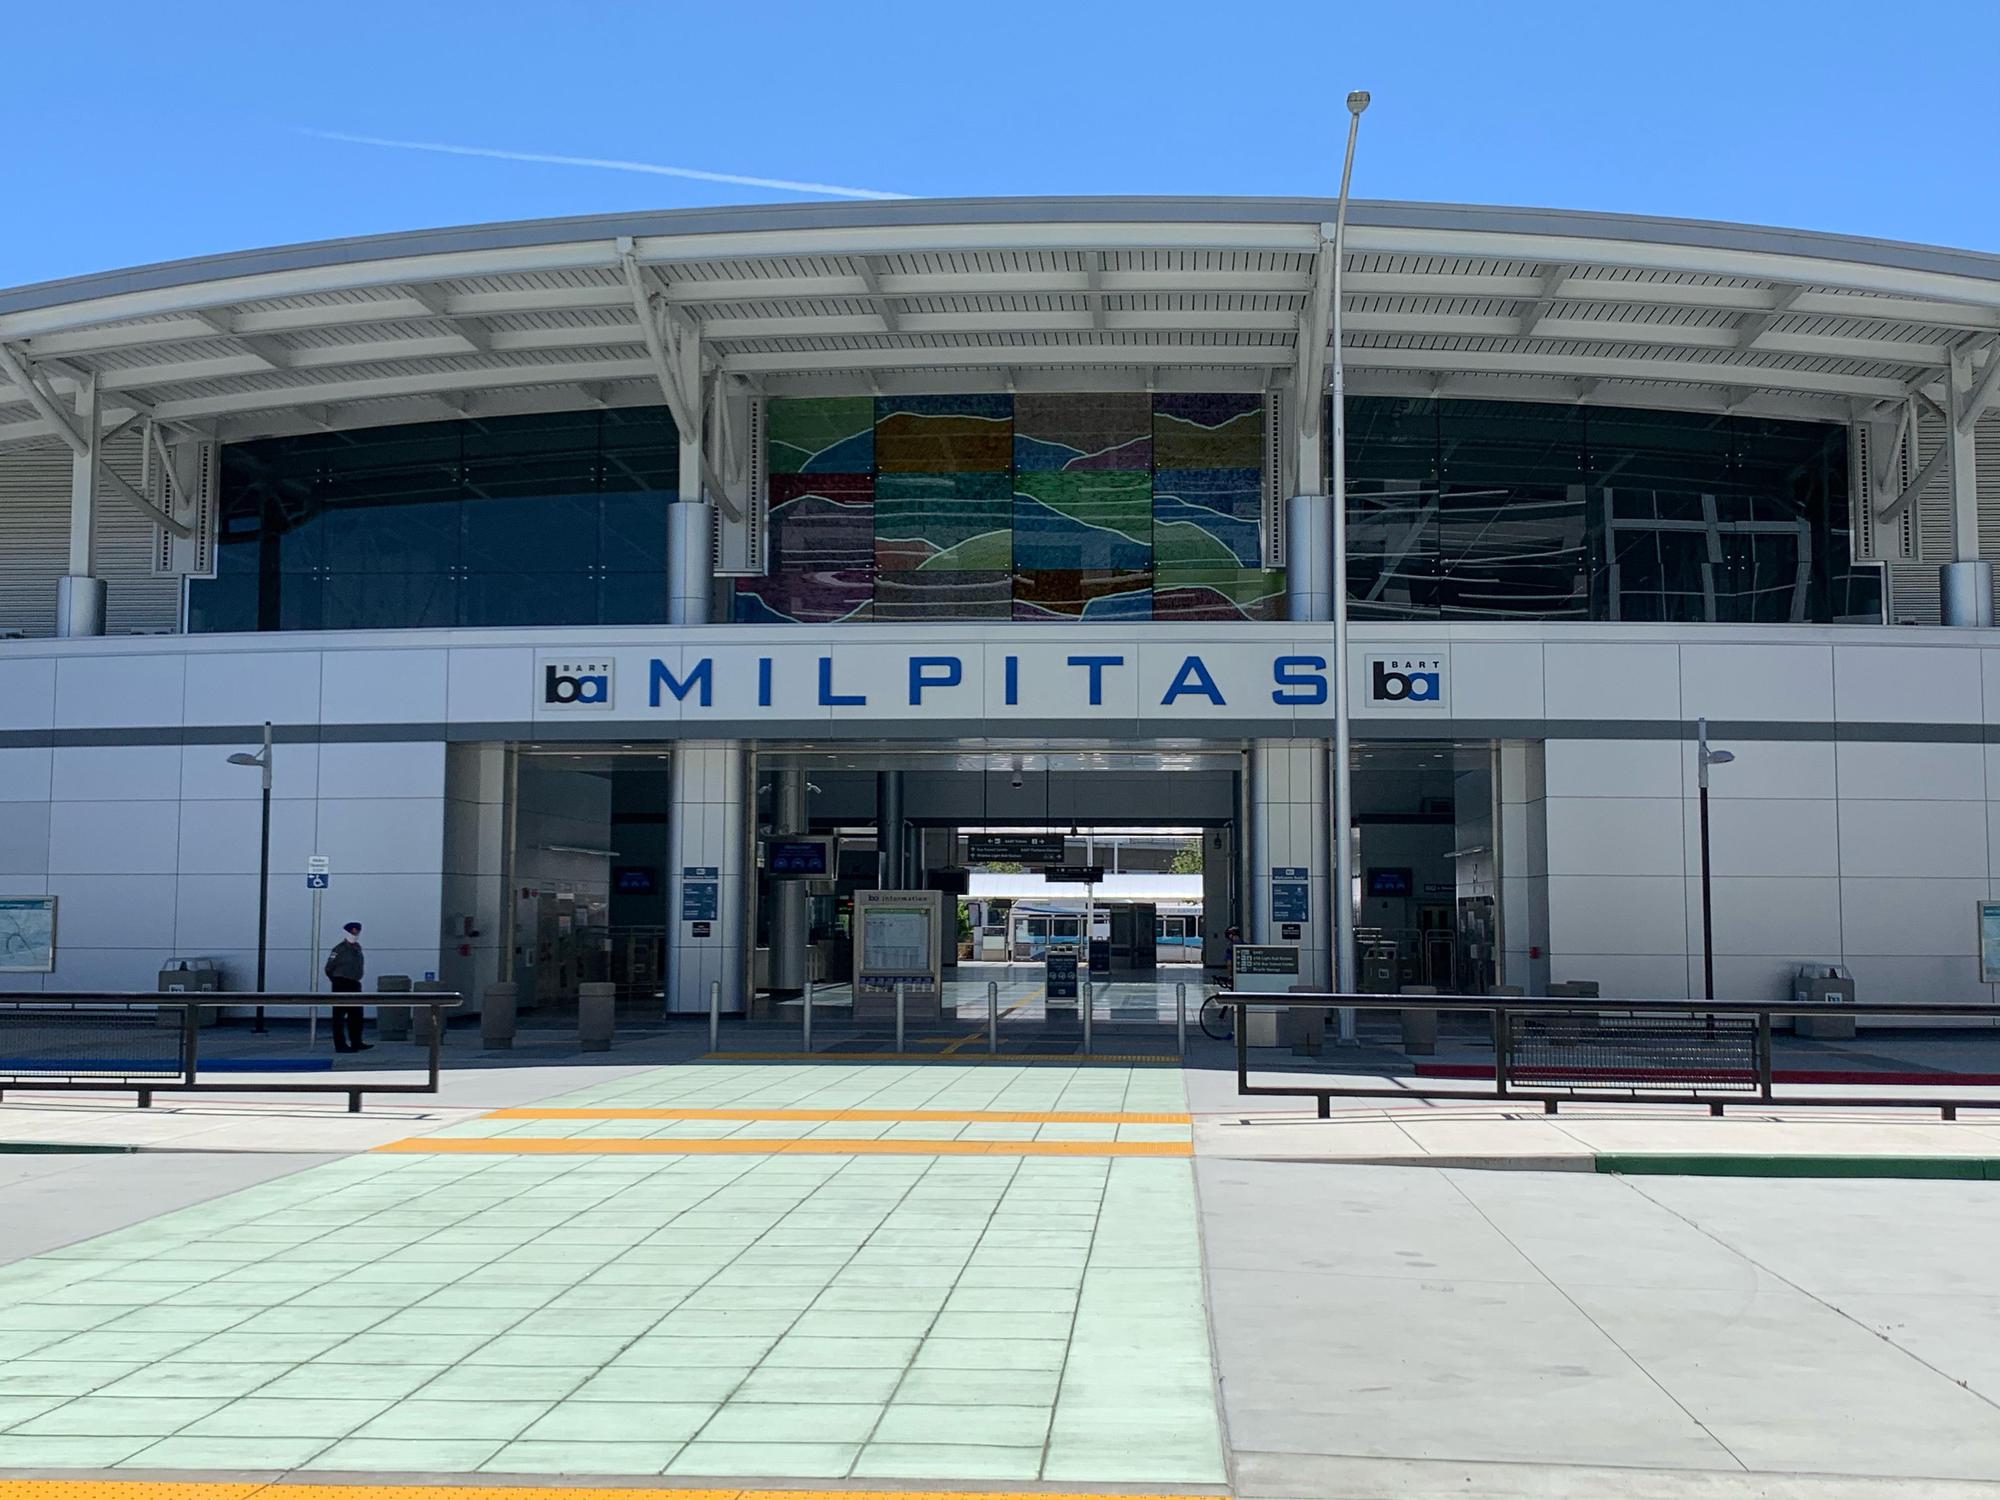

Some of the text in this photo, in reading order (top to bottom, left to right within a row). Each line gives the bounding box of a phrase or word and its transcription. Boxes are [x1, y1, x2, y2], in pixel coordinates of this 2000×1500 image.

[563, 664, 609, 672] BART
[1391, 661, 1440, 669] BART
[649, 656, 1328, 707] MILPITAS
